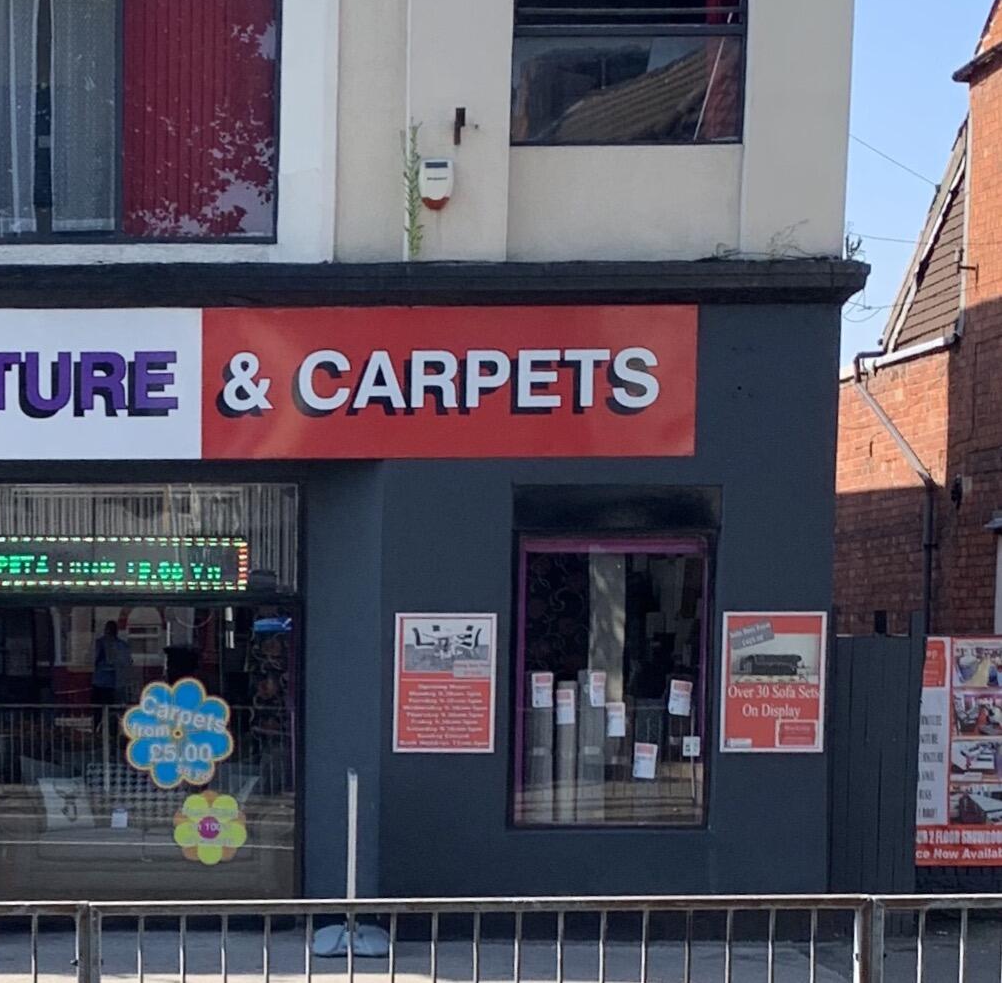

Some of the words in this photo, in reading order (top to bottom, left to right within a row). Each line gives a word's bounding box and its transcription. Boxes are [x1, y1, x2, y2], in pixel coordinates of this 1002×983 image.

[217, 351, 272, 417] &
[294, 347, 660, 416] CARPETS
[728, 685, 755, 698] Over
[758, 685, 770, 698] 30
[772, 685, 796, 698] Sofa
[798, 685, 821, 698] Sets
[141, 696, 226, 734] Carpets
[742, 704, 758, 717] On
[761, 703, 801, 719] Display
[149, 744, 213, 762] £5.00
[933, 847, 958, 859] Now
